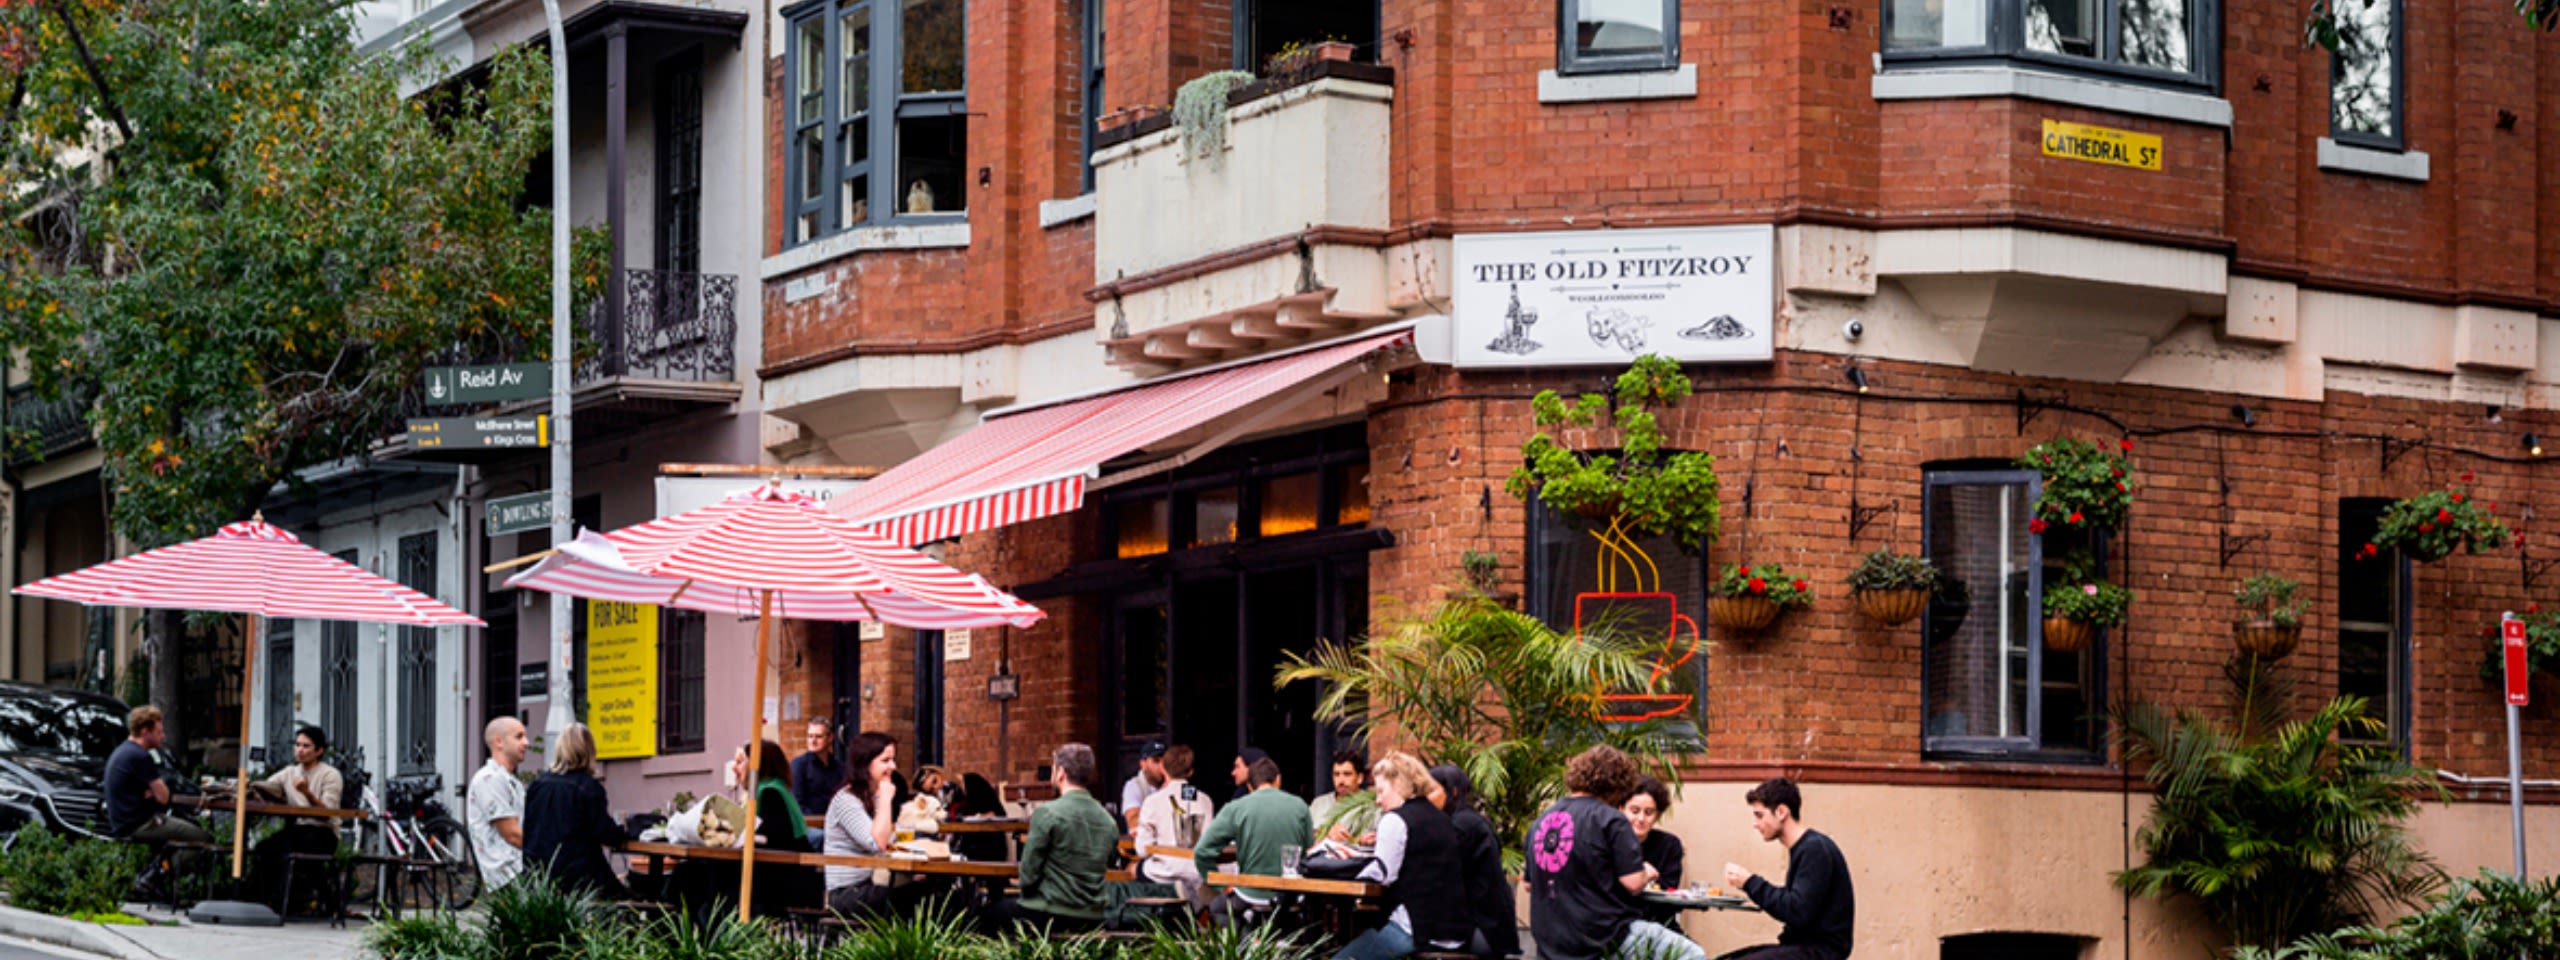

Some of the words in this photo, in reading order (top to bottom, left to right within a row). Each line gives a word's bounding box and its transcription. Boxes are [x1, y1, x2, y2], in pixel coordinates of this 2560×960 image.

[2046, 133, 2130, 163] CATHEDRAL
[1473, 262, 1536, 283] THE
[1544, 259, 1608, 281] OLD
[1617, 255, 1753, 280] FITZROY
[460, 368, 495, 389] Reid
[500, 367, 523, 385] Av
[513, 418, 535, 430] Street
[494, 434, 514, 447] Kings
[515, 434, 536, 445] Cross
[502, 502, 541, 524] DOWLING
[593, 602, 612, 628] FOR
[615, 601, 638, 626] SALE
